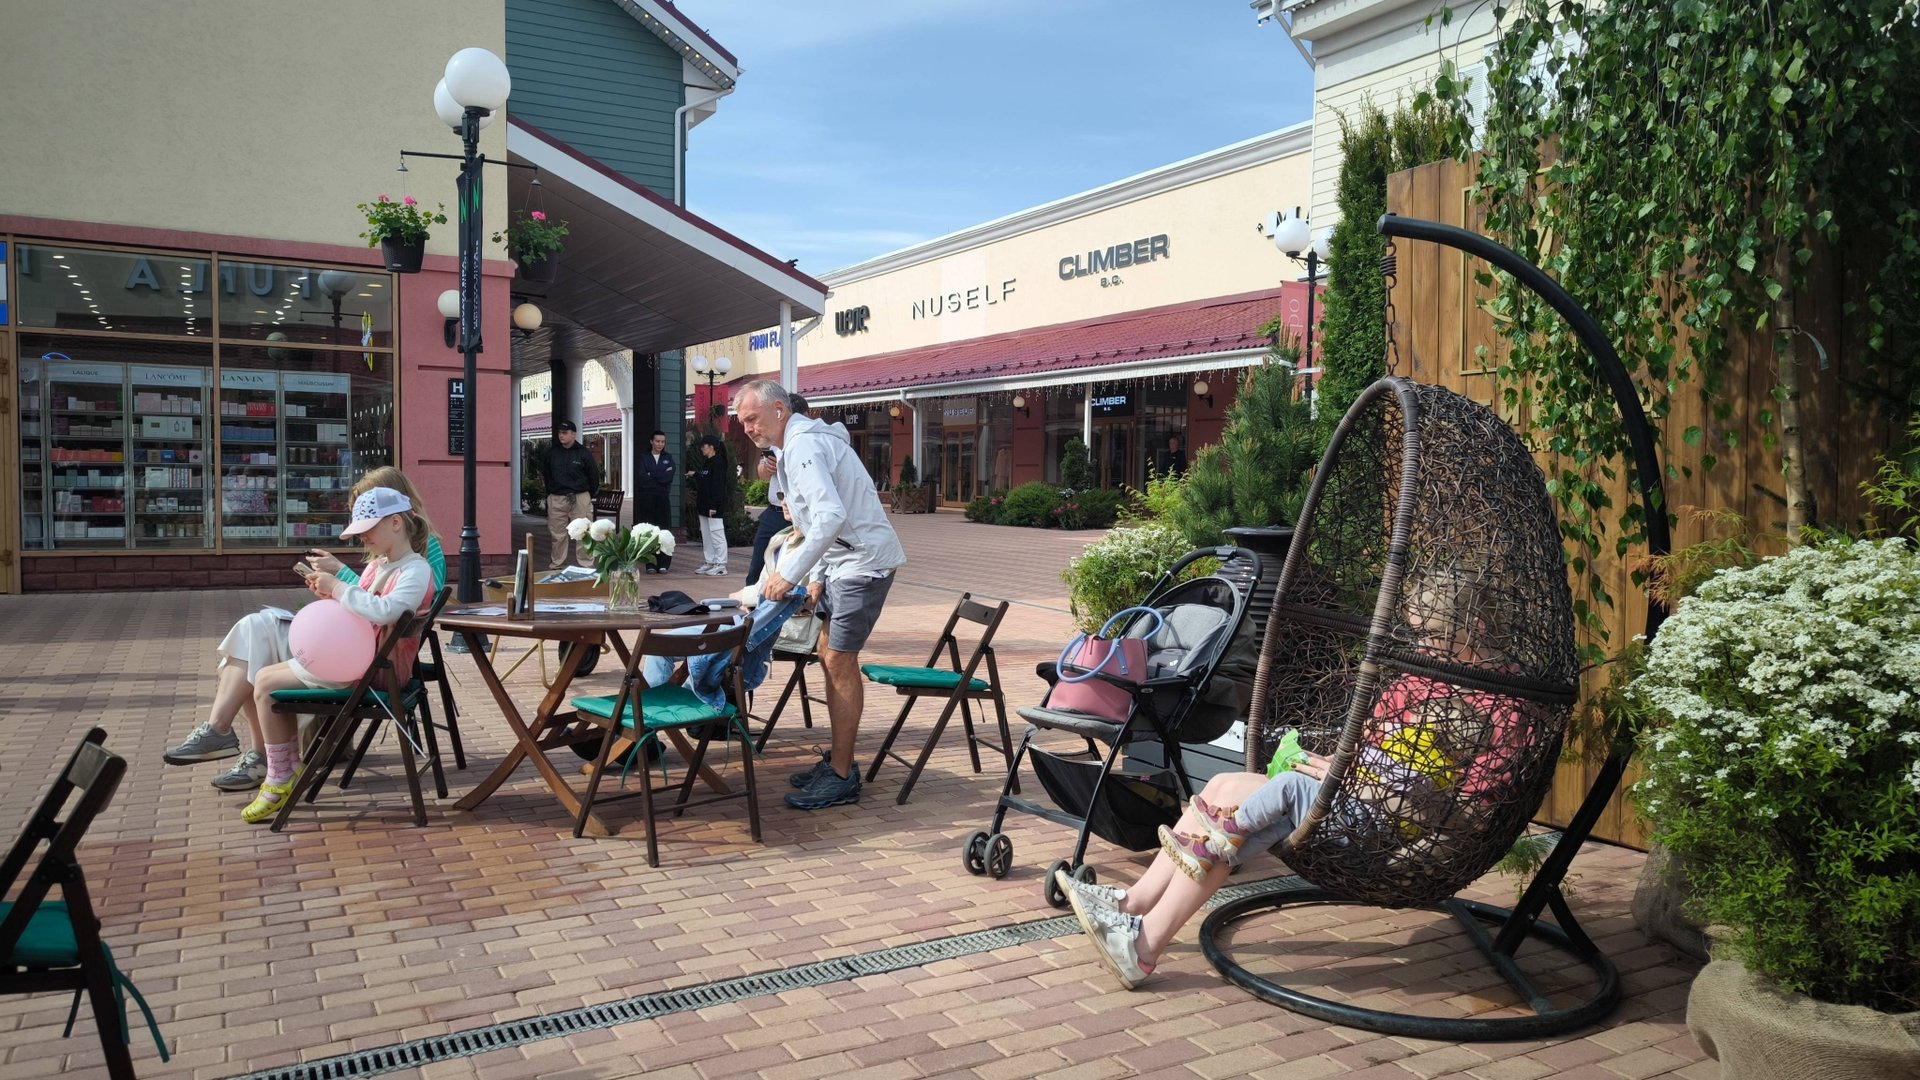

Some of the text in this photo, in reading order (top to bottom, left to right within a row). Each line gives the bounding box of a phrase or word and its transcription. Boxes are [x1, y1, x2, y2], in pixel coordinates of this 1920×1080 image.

[1059, 234, 1170, 281] CLIMBER
[1101, 275, 1124, 288] B.C.
[913, 278, 1016, 320] NUSELF
[749, 333, 769, 351] FINN
[222, 374, 264, 383] LANVIN
[1091, 396, 1127, 407] CLIMBER
